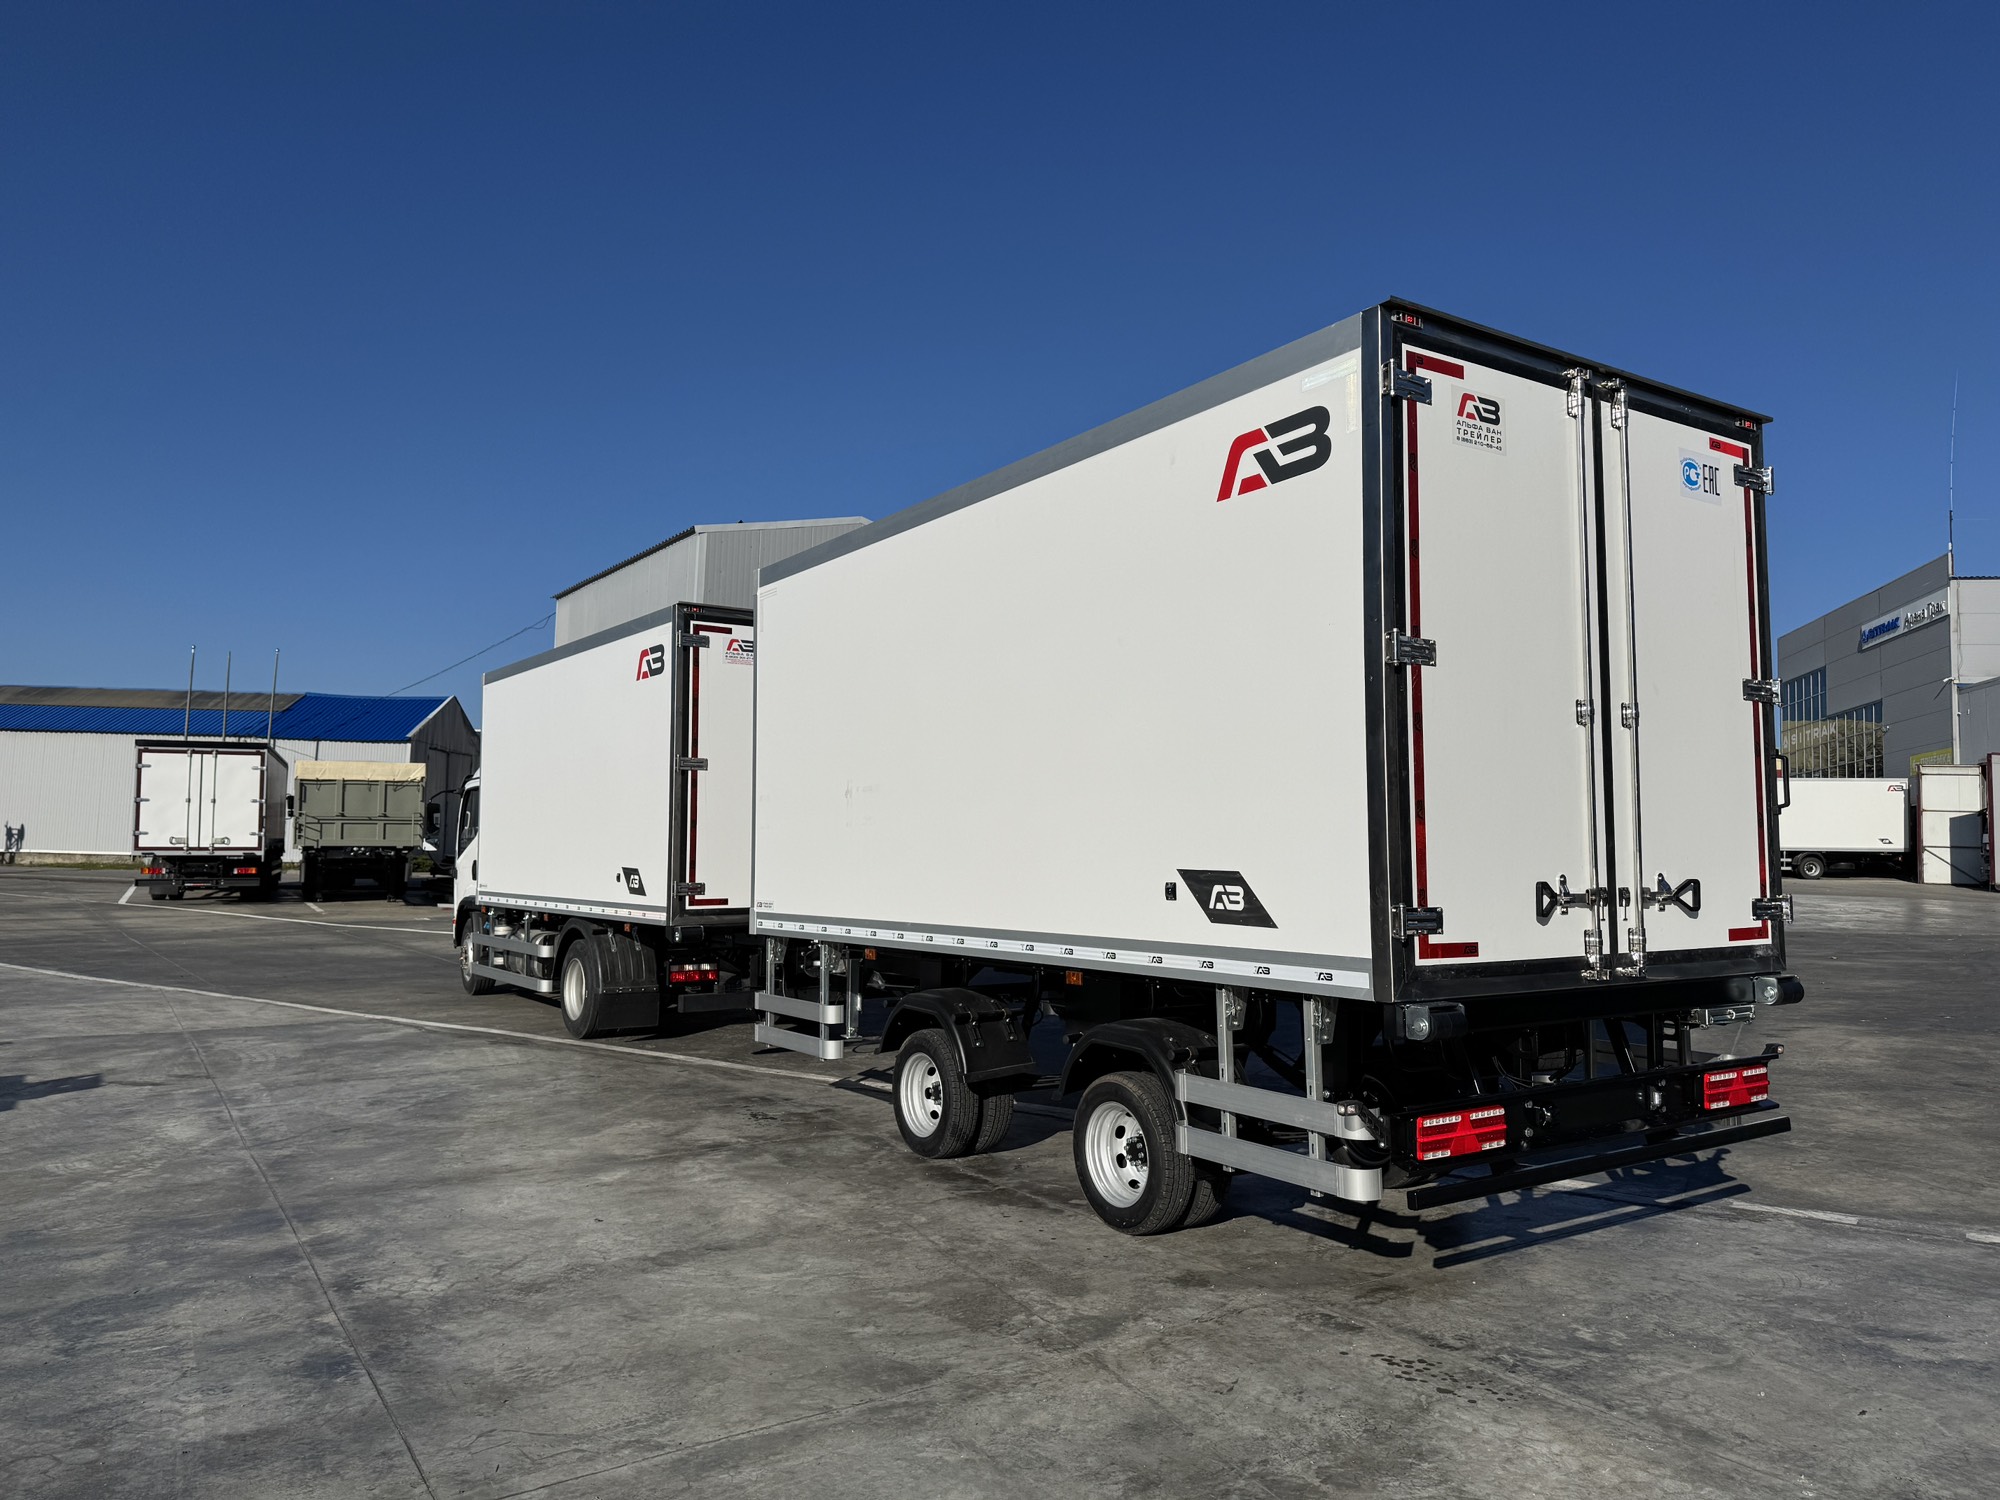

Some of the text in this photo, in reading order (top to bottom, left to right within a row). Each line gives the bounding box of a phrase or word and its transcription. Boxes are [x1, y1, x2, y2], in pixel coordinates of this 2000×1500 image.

[1456, 420, 1502, 436] АЛЬФА ВАН
[1456, 428, 1502, 444] ТРЕЙЛЕР
